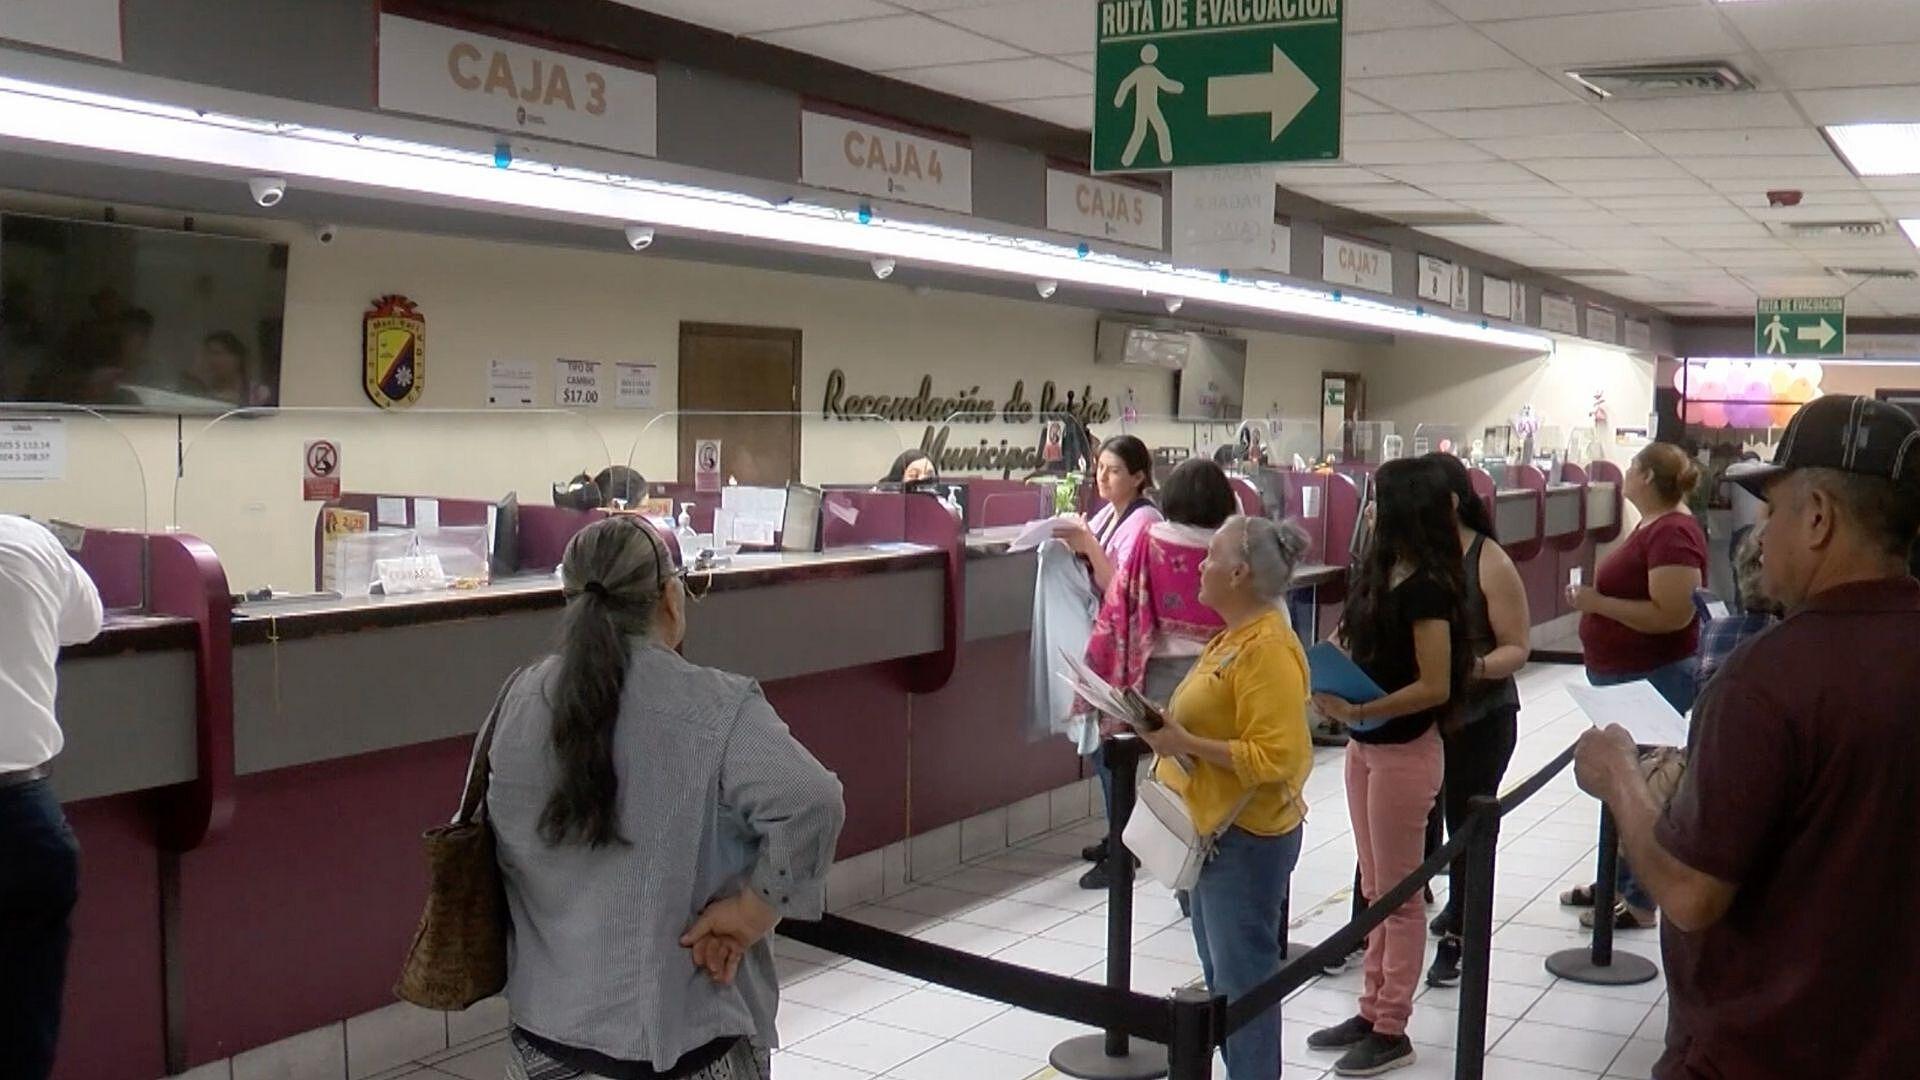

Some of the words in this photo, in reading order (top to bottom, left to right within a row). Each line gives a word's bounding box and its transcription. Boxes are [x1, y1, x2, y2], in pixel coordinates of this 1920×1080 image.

[1102, 0, 1154, 36] RUTA
[1161, 0, 1188, 29] DE
[448, 40, 576, 111] CAJA
[584, 71, 607, 115] 3
[844, 130, 922, 180] CAJA
[928, 149, 943, 184] 4
[1076, 184, 1130, 222] CAJA
[1134, 197, 1143, 225] 5
[1338, 247, 1371, 274] CAJA
[1371, 254, 1378, 276] 7
[563, 388, 599, 403] $17.00
[823, 368, 996, 423] Recaudación
[1003, 379, 1033, 424] de
